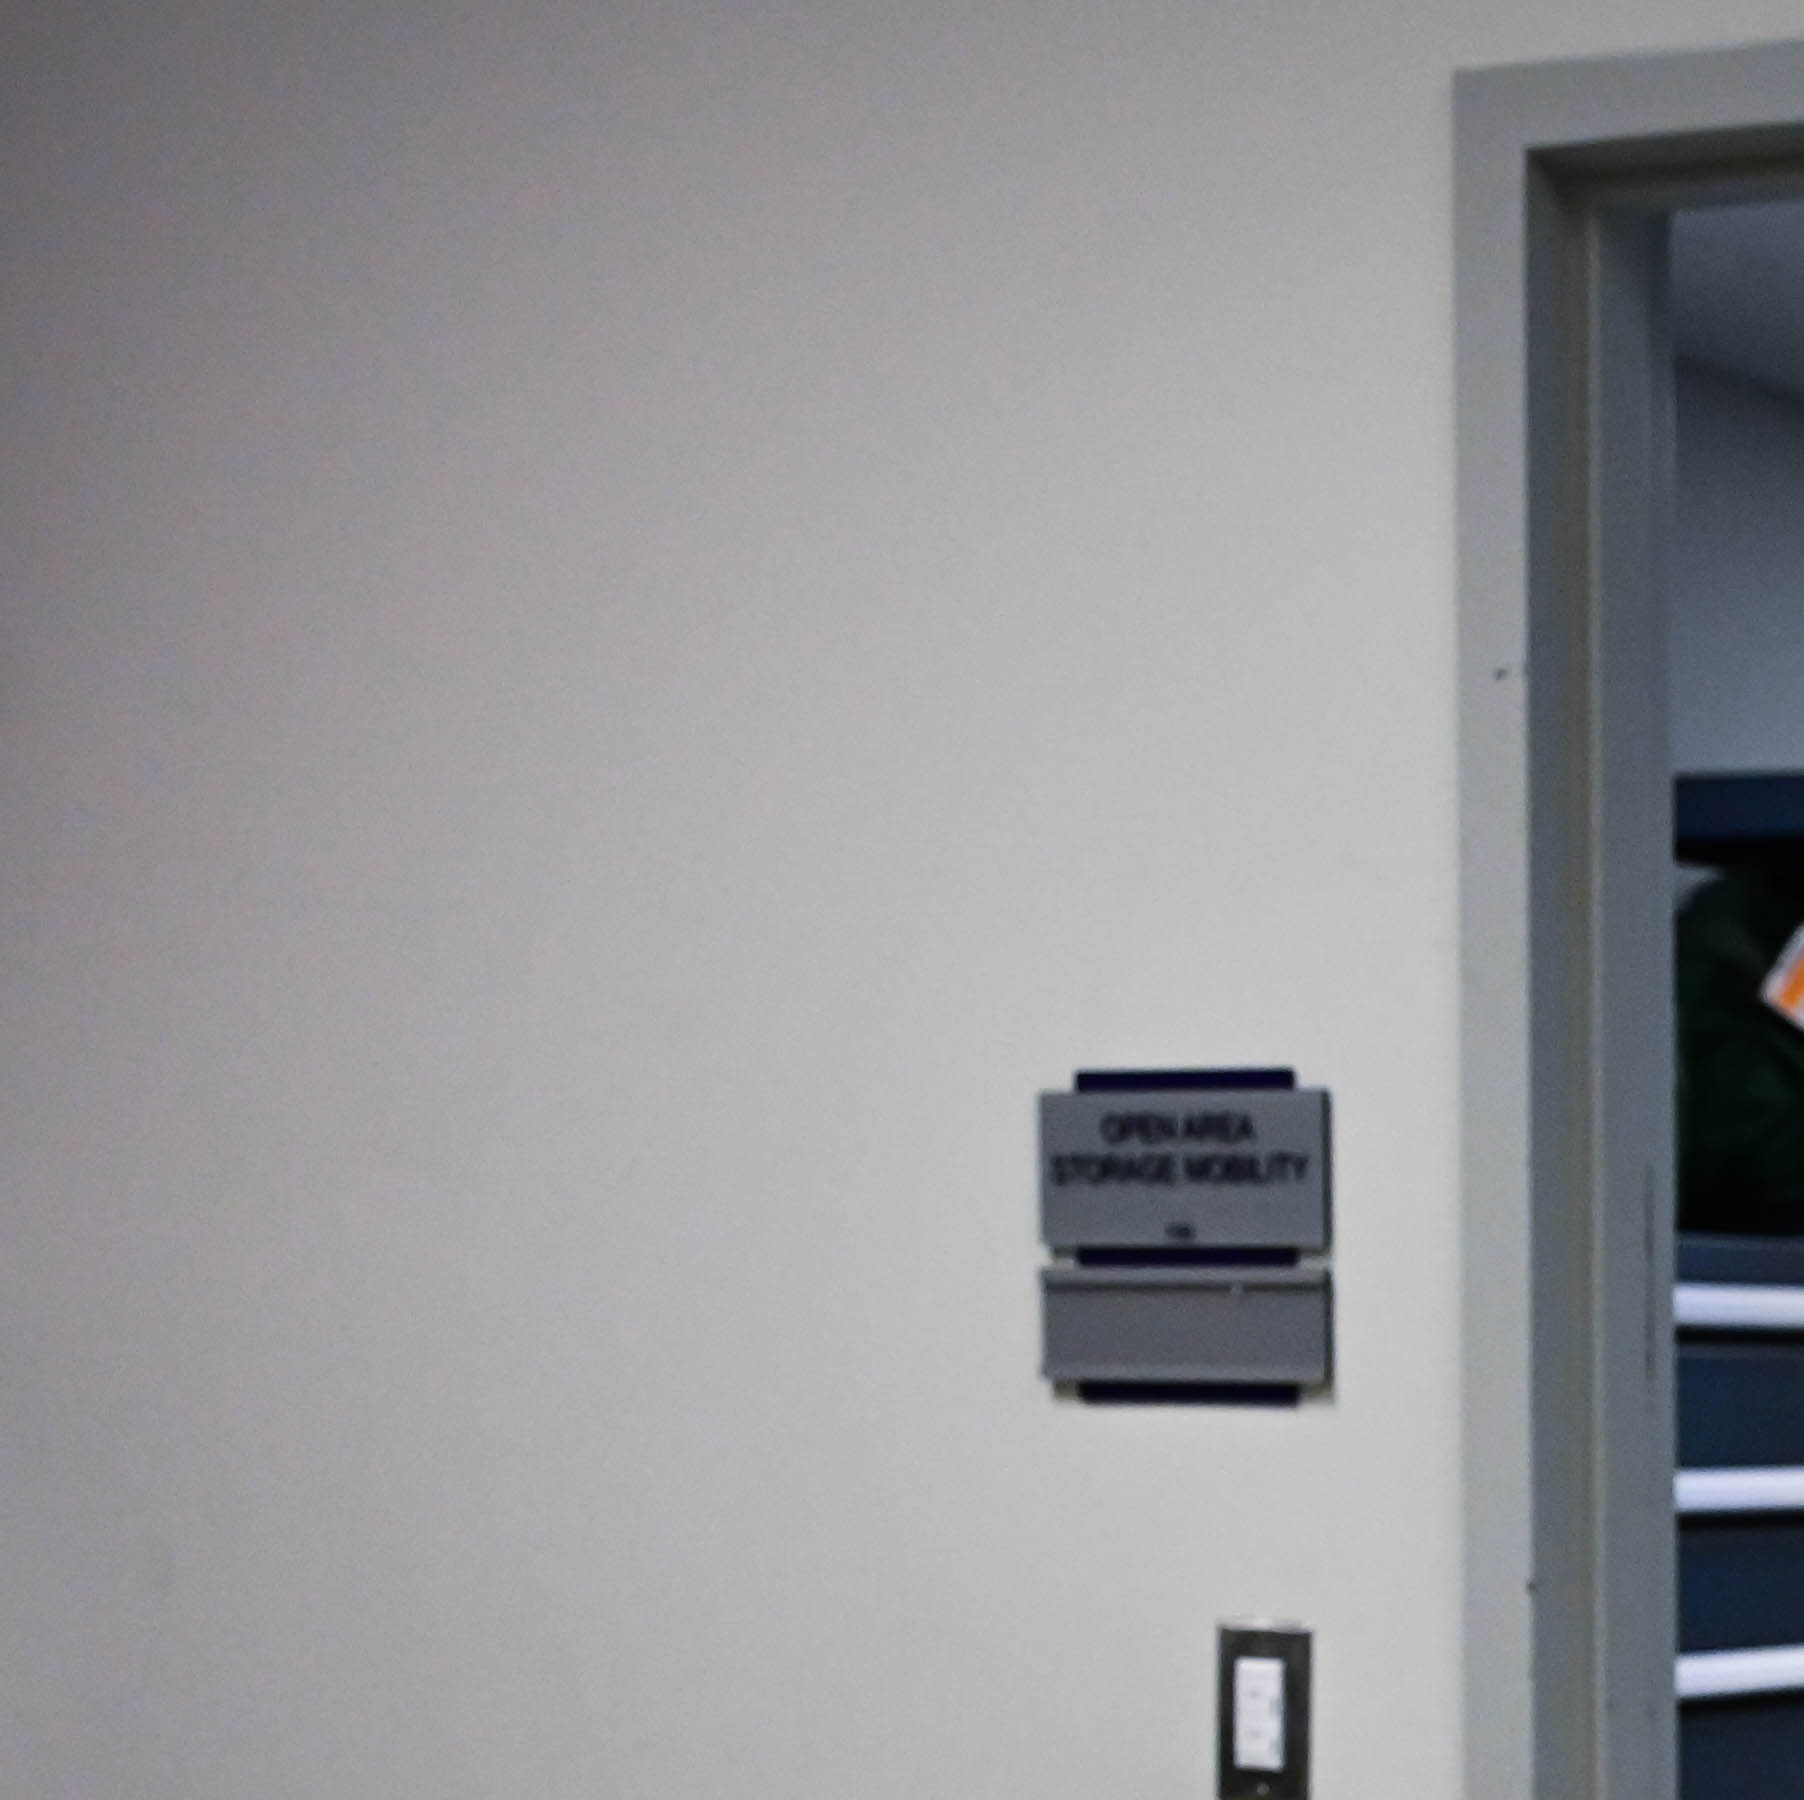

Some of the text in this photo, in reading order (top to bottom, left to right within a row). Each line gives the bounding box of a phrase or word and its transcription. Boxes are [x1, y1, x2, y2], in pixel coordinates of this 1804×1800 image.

[1101, 1110, 1255, 1144] OPEN AREA
[1052, 1151, 1309, 1186] STORAGE MOBILITY
